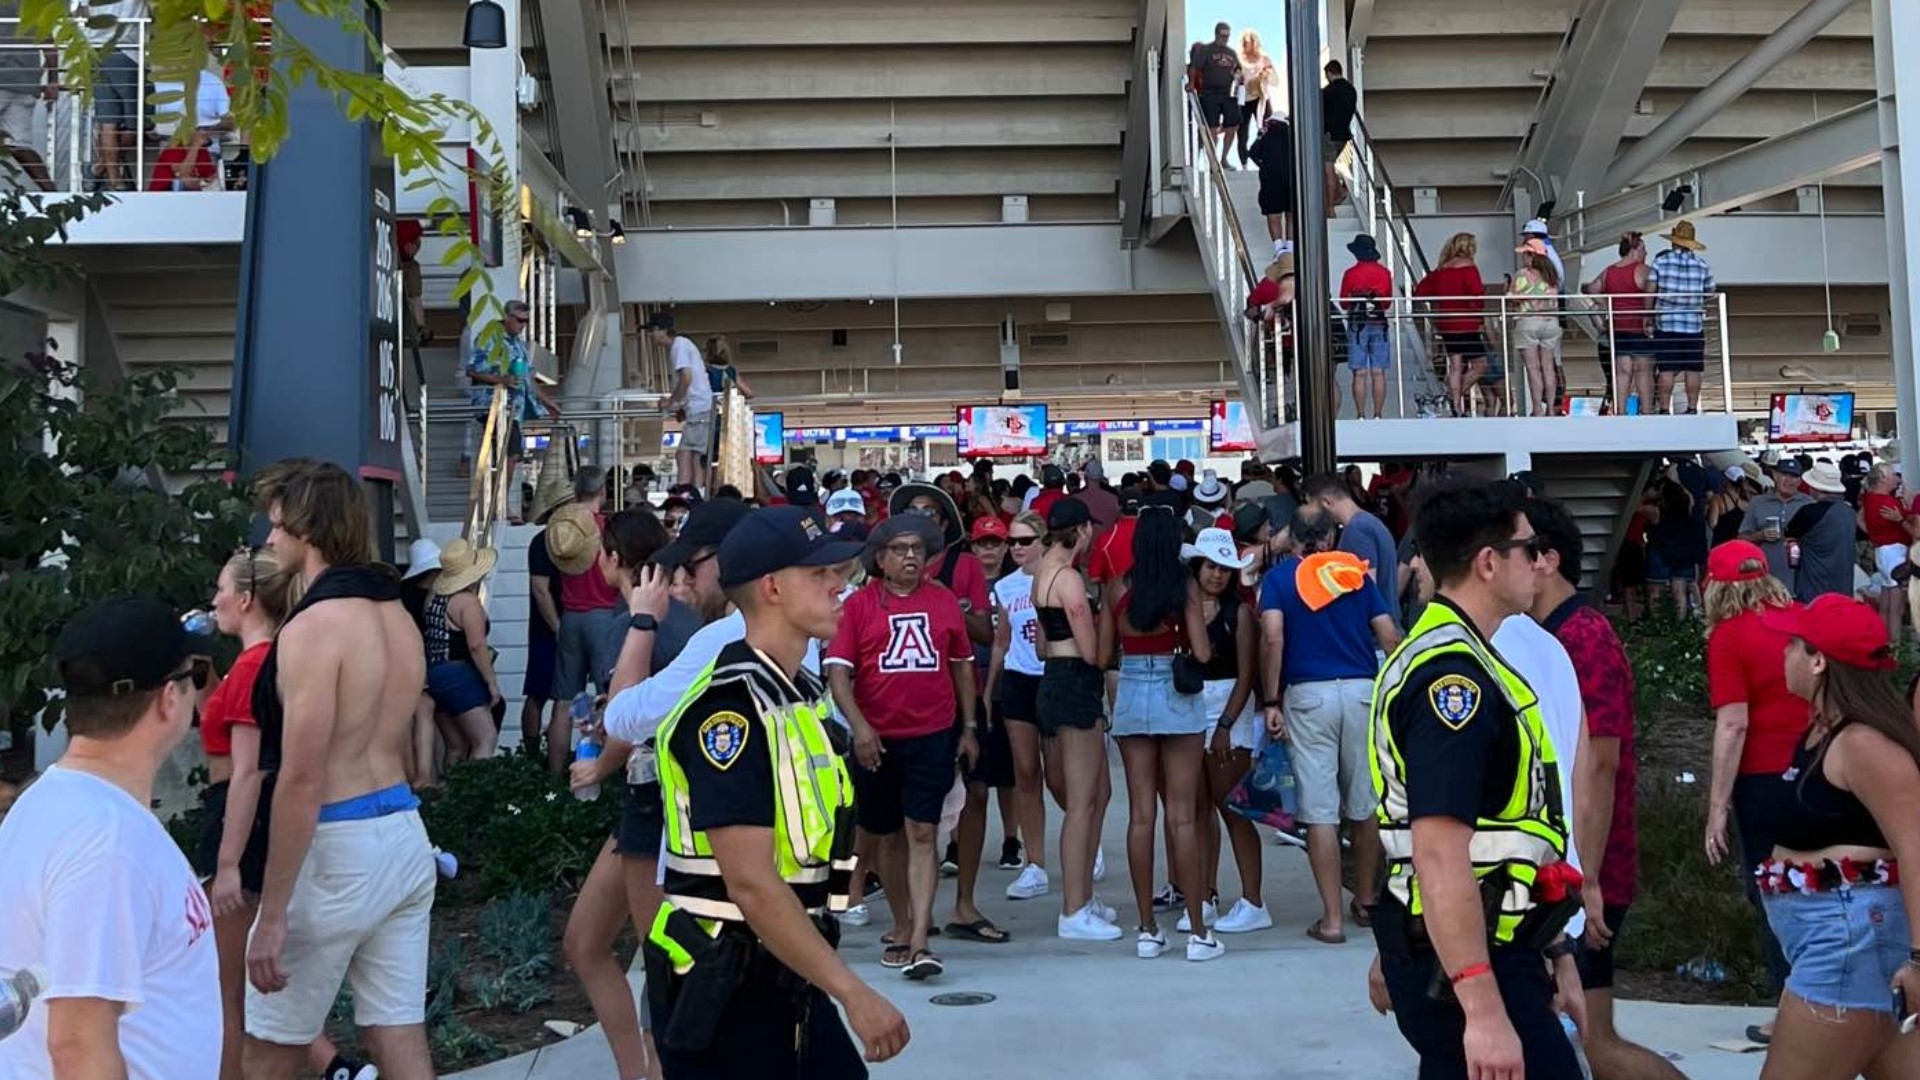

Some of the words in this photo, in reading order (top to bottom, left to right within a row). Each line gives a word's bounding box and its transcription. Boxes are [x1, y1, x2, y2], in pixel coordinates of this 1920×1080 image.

[379, 339, 395, 390] 105
[379, 391, 396, 443] 106
[879, 612, 939, 673] A
